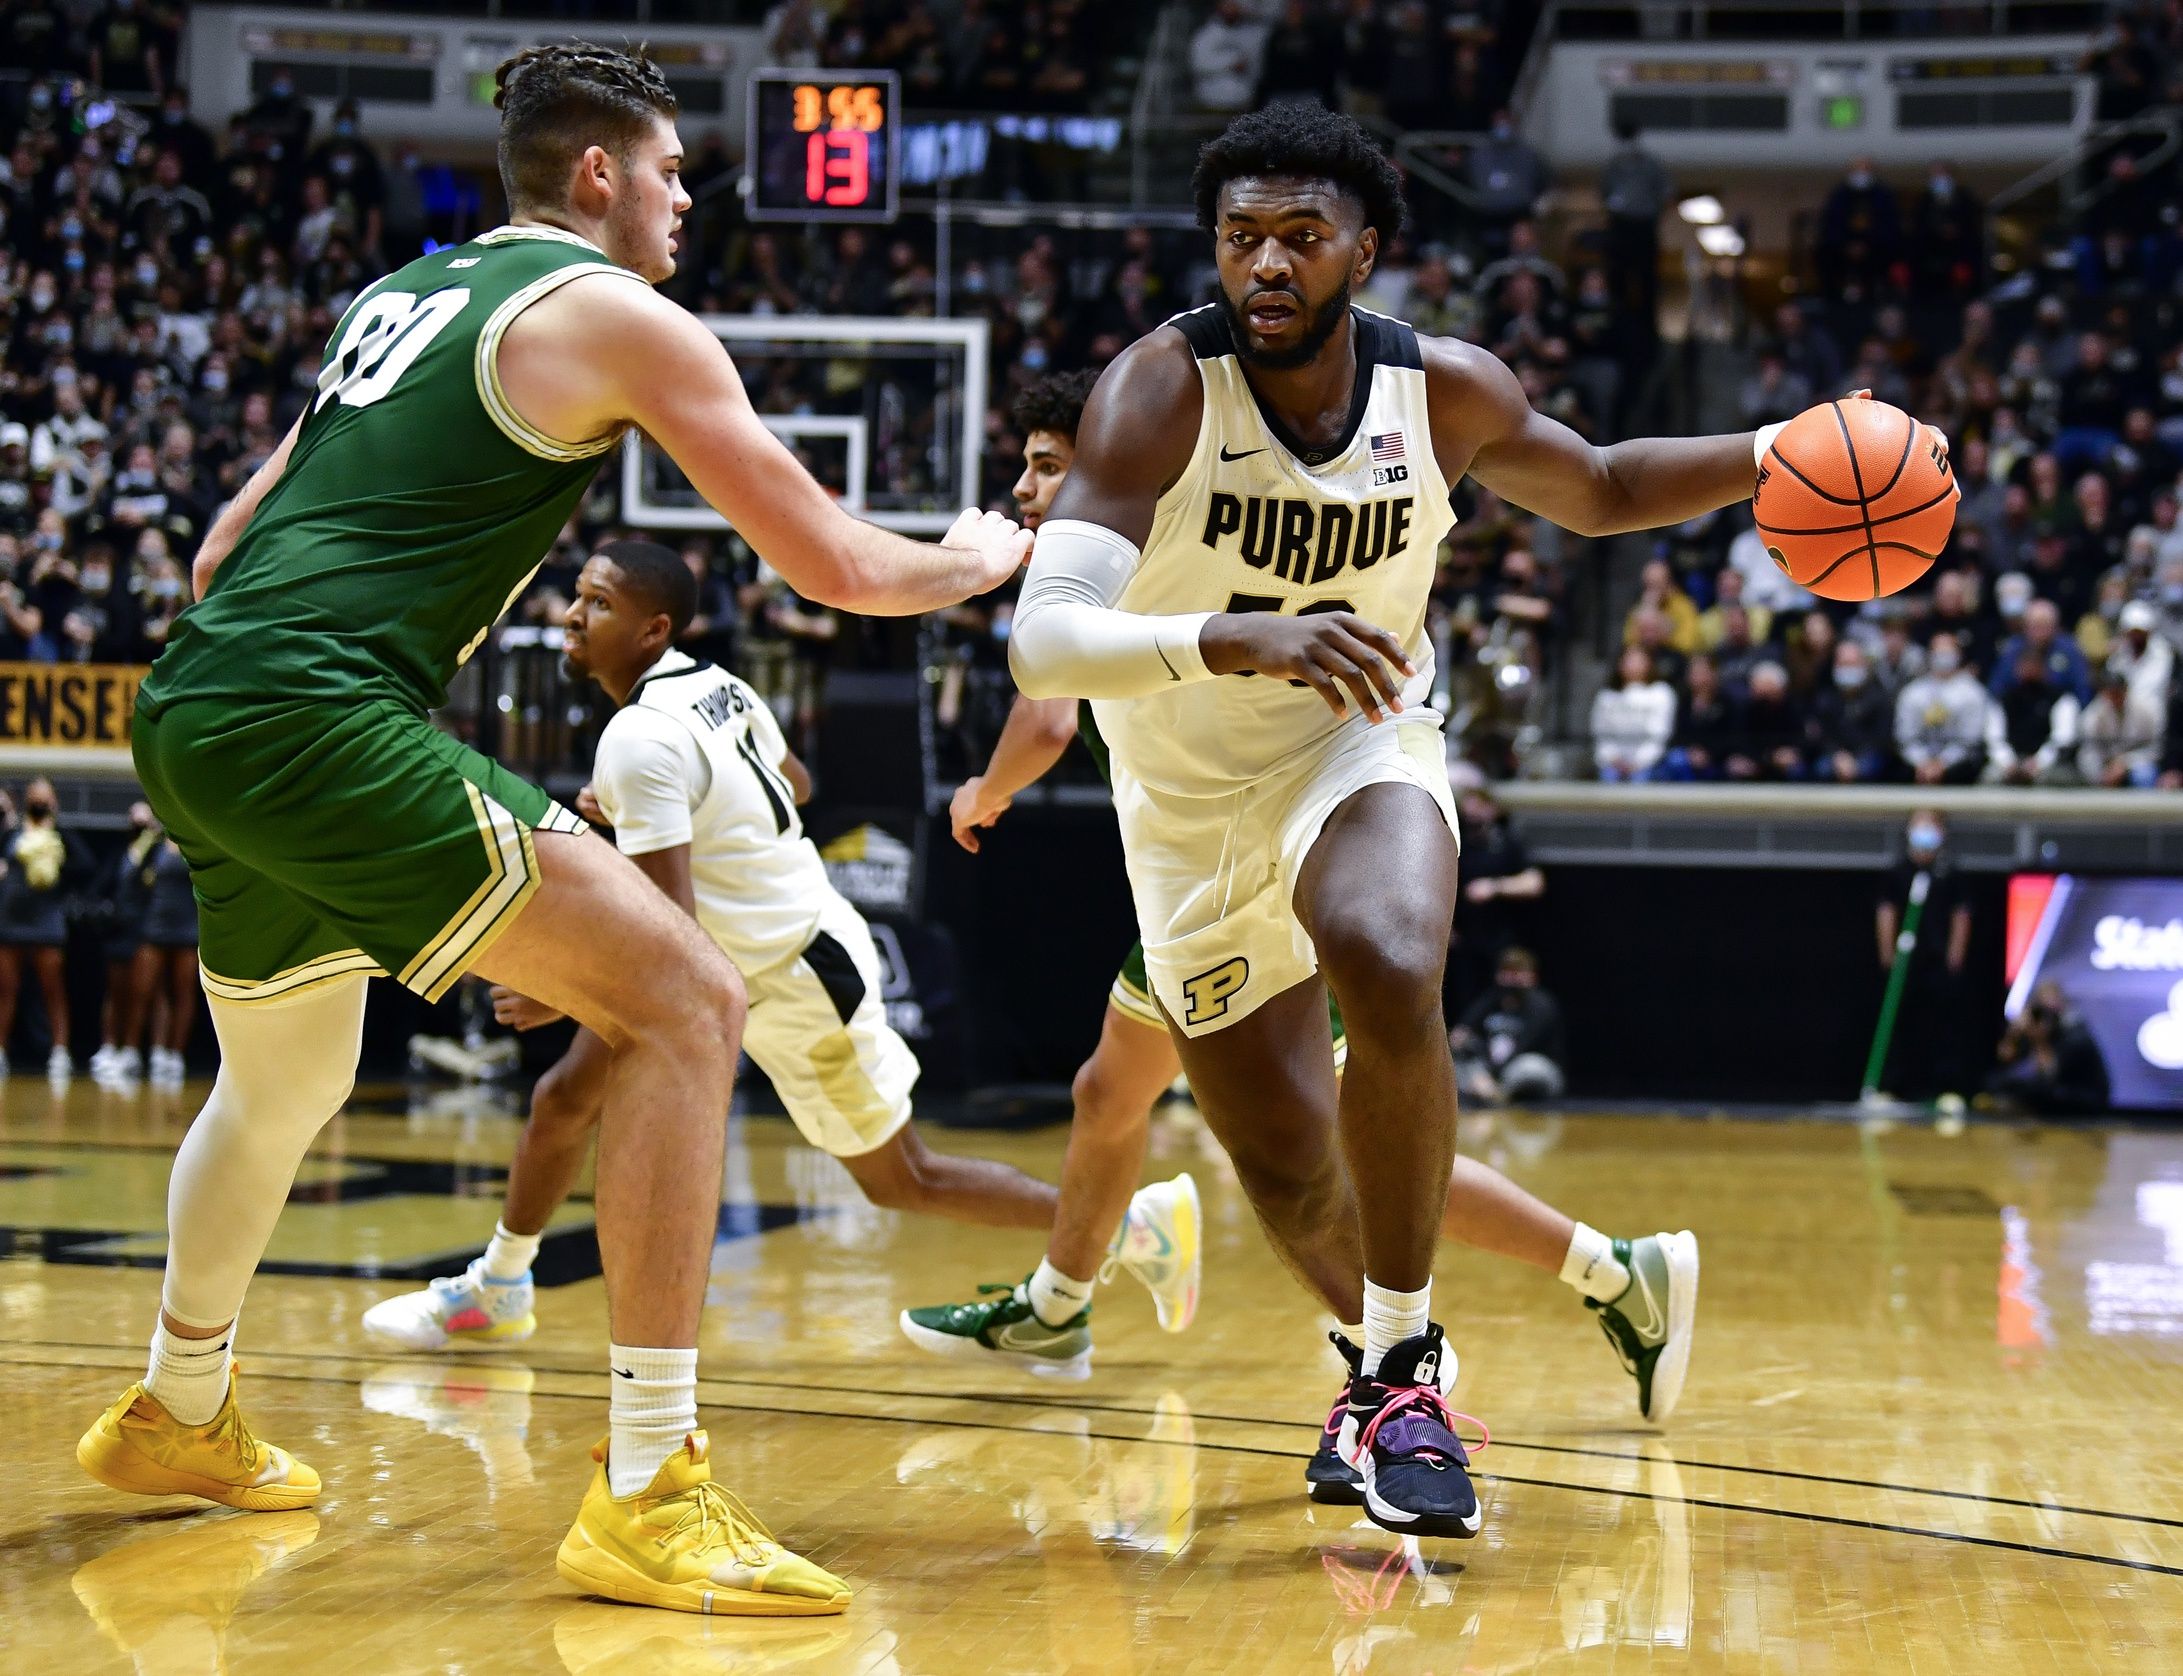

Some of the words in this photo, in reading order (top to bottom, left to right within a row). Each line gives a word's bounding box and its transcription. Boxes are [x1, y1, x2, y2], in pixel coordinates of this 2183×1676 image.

[806, 131, 869, 206] 13
[1201, 491, 1415, 586] PURDUE
[1182, 956, 1250, 1026] P
